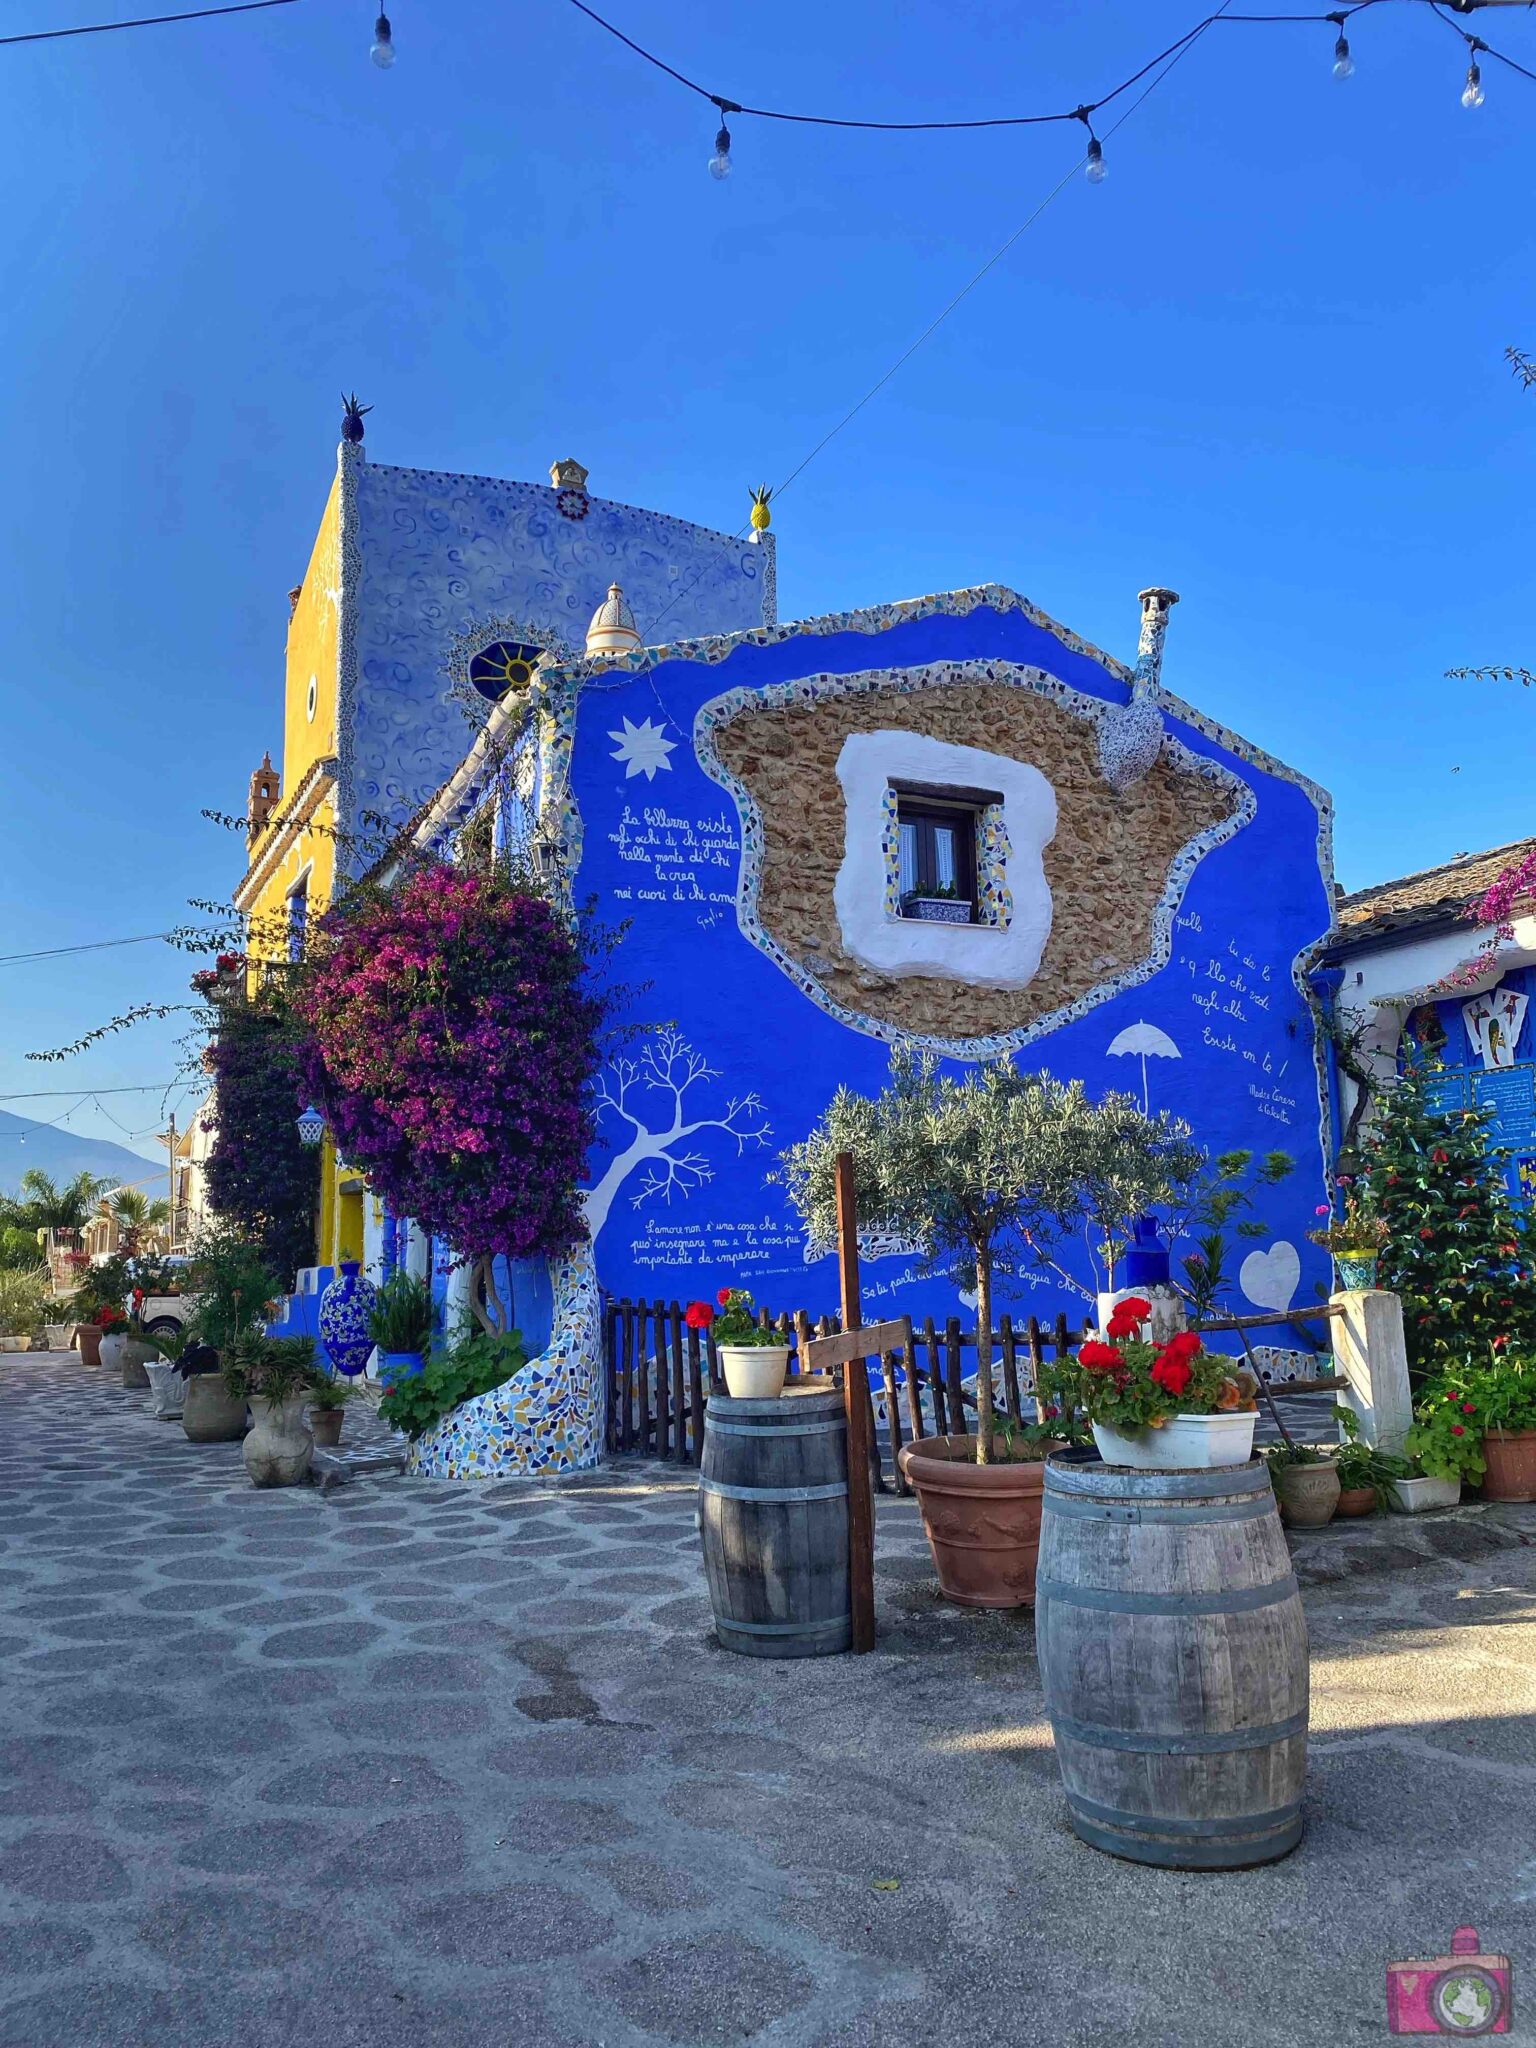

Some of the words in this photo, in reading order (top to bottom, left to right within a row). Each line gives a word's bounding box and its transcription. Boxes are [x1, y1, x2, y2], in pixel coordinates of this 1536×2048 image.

[622, 806, 641, 825] La
[644, 808, 690, 829] bellezza
[696, 812, 733, 833] esiste
[635, 828, 661, 844] occhi
[665, 831, 678, 846] di
[682, 829, 700, 846] chi
[702, 835, 740, 858] guarda
[618, 846, 652, 863] nella
[655, 848, 685, 863] mente
[689, 848, 705, 863] di
[711, 851, 731, 867] chi
[655, 864, 668, 881] la
[669, 872, 696, 881] crea
[614, 886, 633, 899] nei
[638, 889, 667, 901] cuori
[673, 884, 686, 901] di
[688, 883, 707, 901] chi
[709, 893, 737, 907] ama
[1175, 911, 1203, 933] quello
[1228, 938, 1239, 958] tu
[1230, 974, 1247, 992] che
[1192, 990, 1220, 1016] negli
[1202, 1026, 1237, 1053] Esiste
[1242, 1050, 1257, 1064] in
[1262, 1051, 1272, 1074] te
[684, 1224, 701, 1235] non
[716, 1223, 735, 1231] una
[737, 1223, 757, 1231] cosa
[759, 1215, 778, 1231] che
[654, 1239, 706, 1256] insegnare
[712, 1239, 729, 1248] ma
[745, 1231, 758, 1246] la
[762, 1236, 783, 1245] cosa
[633, 1250, 693, 1271] importante
[698, 1248, 714, 1265] da
[861, 1287, 877, 1300] Se
[876, 1281, 889, 1296] tu
[889, 1268, 917, 1297] parli
